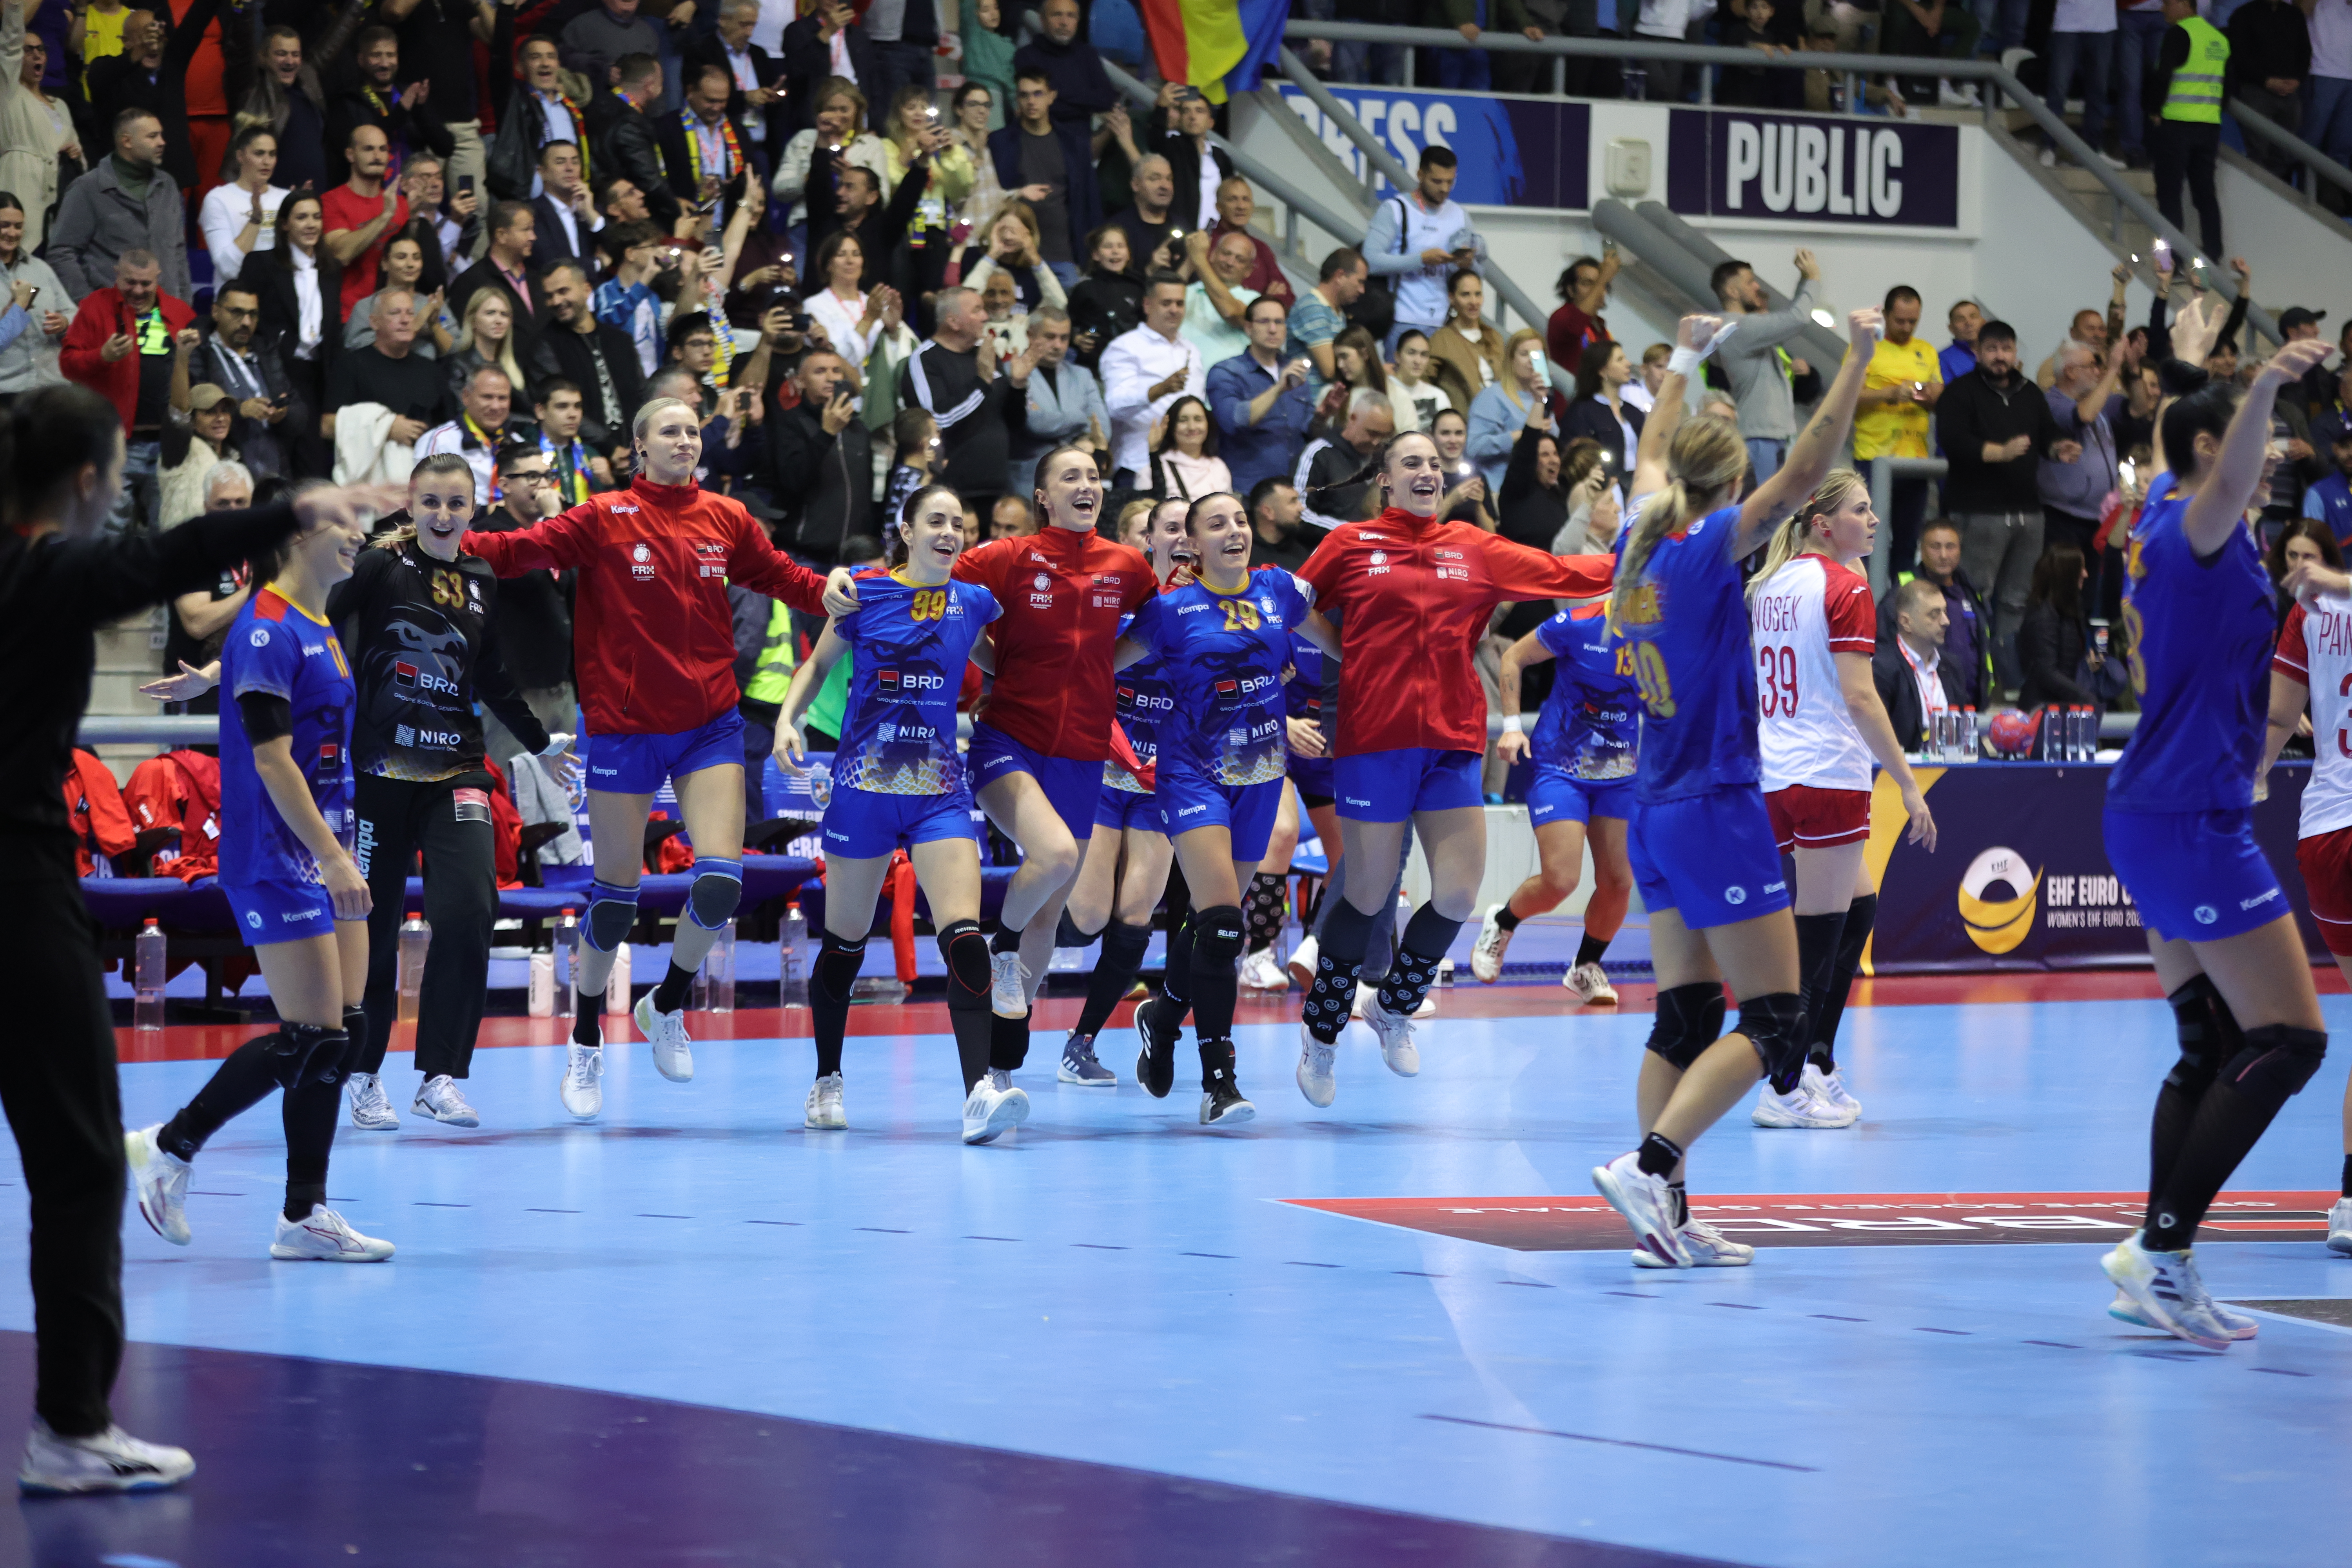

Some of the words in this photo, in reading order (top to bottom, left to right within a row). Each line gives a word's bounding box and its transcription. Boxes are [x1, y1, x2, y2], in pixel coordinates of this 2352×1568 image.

[1726, 119, 1904, 218] PUBLIC
[1444, 551, 1463, 560] BRD
[1448, 567, 1468, 577] NIRO
[1103, 576, 1120, 584] BRD
[432, 568, 465, 610] 53
[910, 589, 947, 622] 99
[1177, 604, 1209, 616] Kempa
[1218, 599, 1261, 632] 29
[1753, 595, 1802, 633] NOSEK
[903, 675, 944, 690] BRD
[1760, 646, 1798, 719] 39
[1136, 694, 1174, 710] BRD
[419, 729, 462, 746] NIRO
[899, 726, 936, 739] NIRO
[1131, 740, 1157, 755] NIR
[984, 755, 1013, 770] Kempa
[592, 765, 617, 777] Kempa
[1345, 796, 1371, 808] Kempa
[1178, 804, 1207, 817] Kempa
[826, 828, 849, 842] Kempa
[1991, 859, 2009, 873] EHF
[2047, 875, 2075, 907] EHF
[2078, 874, 2119, 906] EURO
[282, 908, 321, 923] Kempa
[2047, 909, 2086, 928] WOMEN'S
[2087, 910, 2102, 928] EHF
[2103, 910, 2123, 927] EURO
[1217, 929, 1239, 938] SELECT
[1437, 1205, 1762, 1214] GEERALE
[1693, 1215, 2139, 1232] BRD
